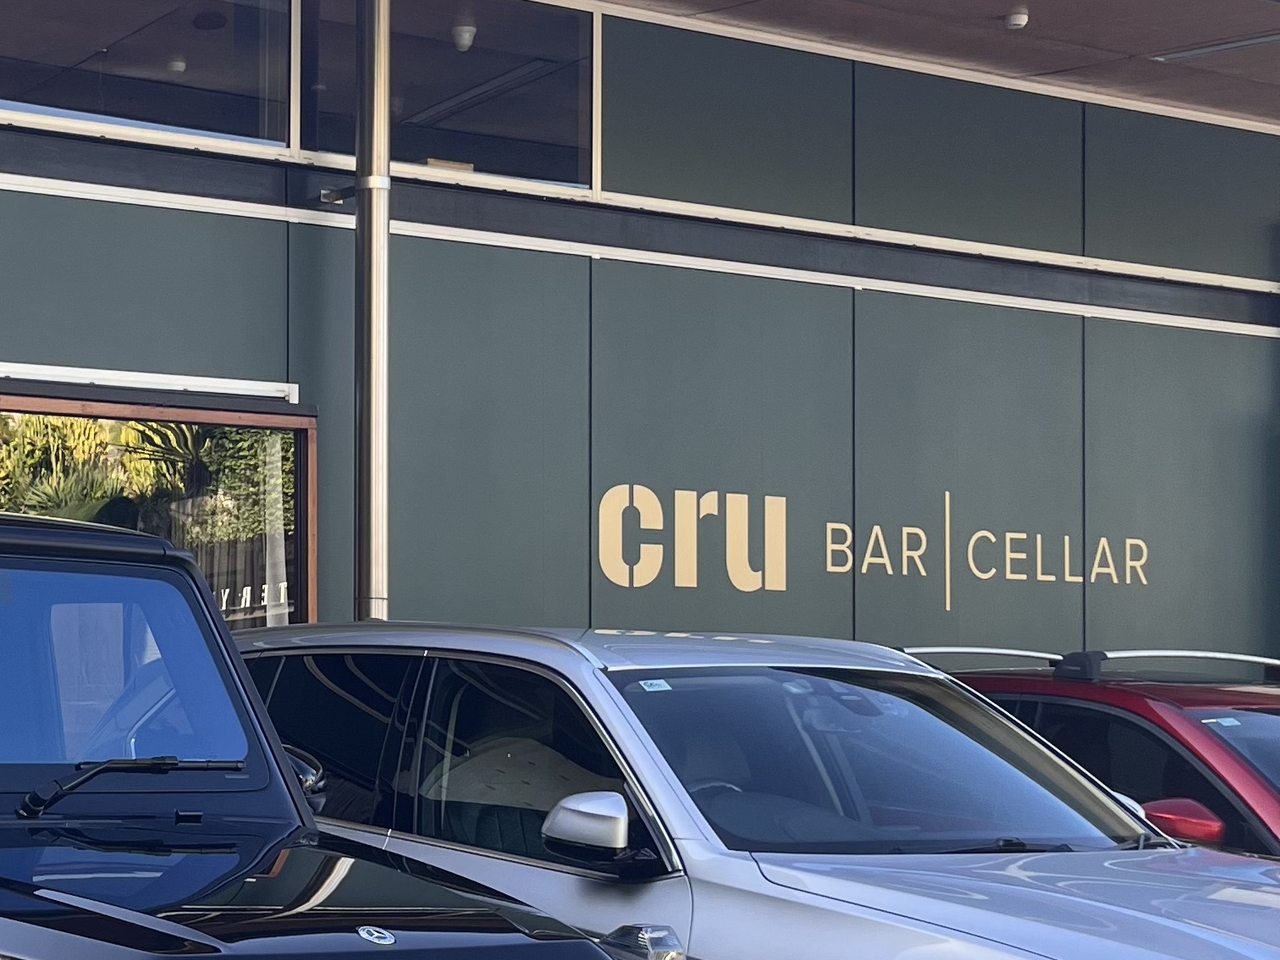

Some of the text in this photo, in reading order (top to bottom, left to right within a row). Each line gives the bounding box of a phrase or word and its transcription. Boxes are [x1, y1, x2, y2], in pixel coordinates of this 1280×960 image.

[598, 483, 1148, 592] cru BAR CELLAR
